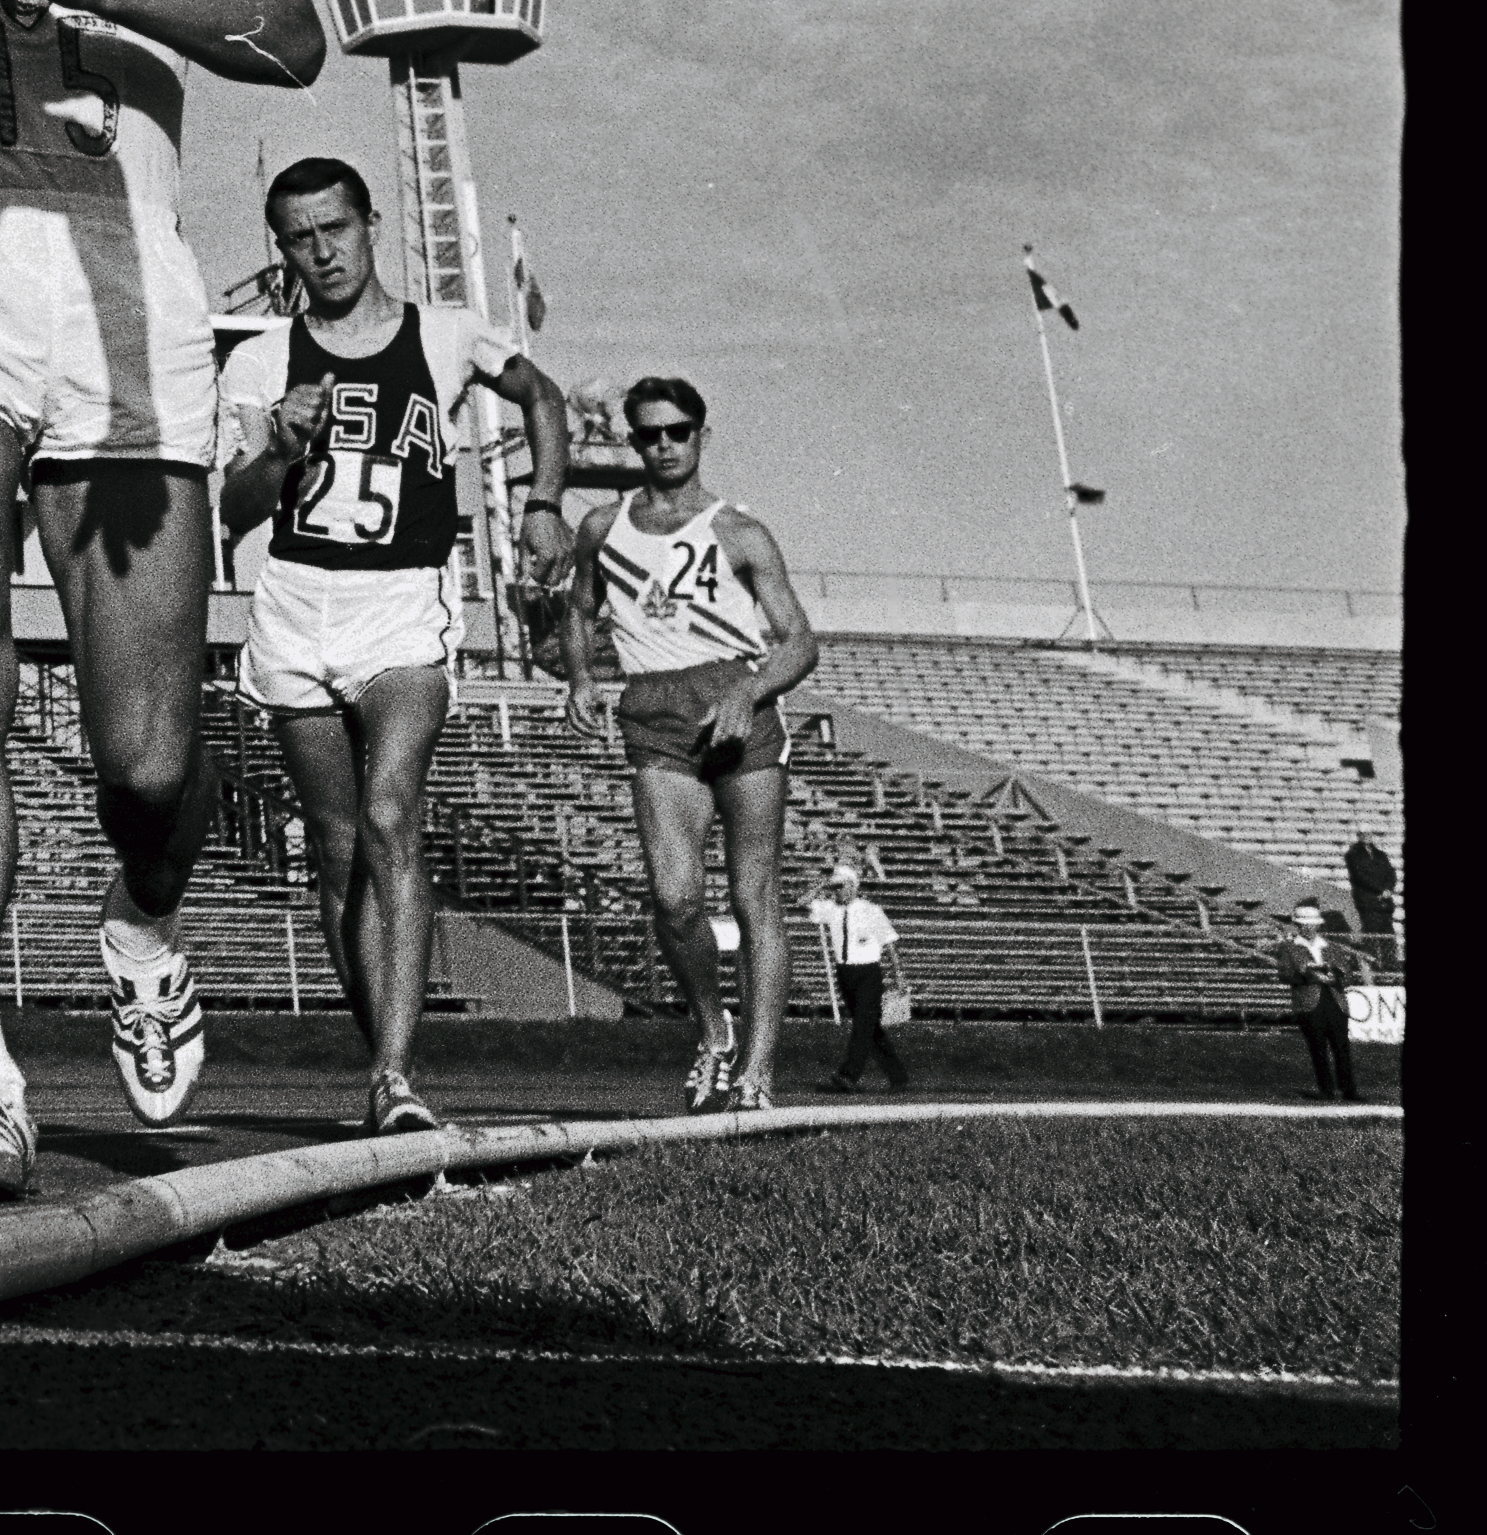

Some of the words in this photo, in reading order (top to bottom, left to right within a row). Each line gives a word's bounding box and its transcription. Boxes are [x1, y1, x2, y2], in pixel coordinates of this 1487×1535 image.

[328, 383, 443, 479] SA
[297, 453, 401, 540] 25
[668, 540, 718, 603] 24
